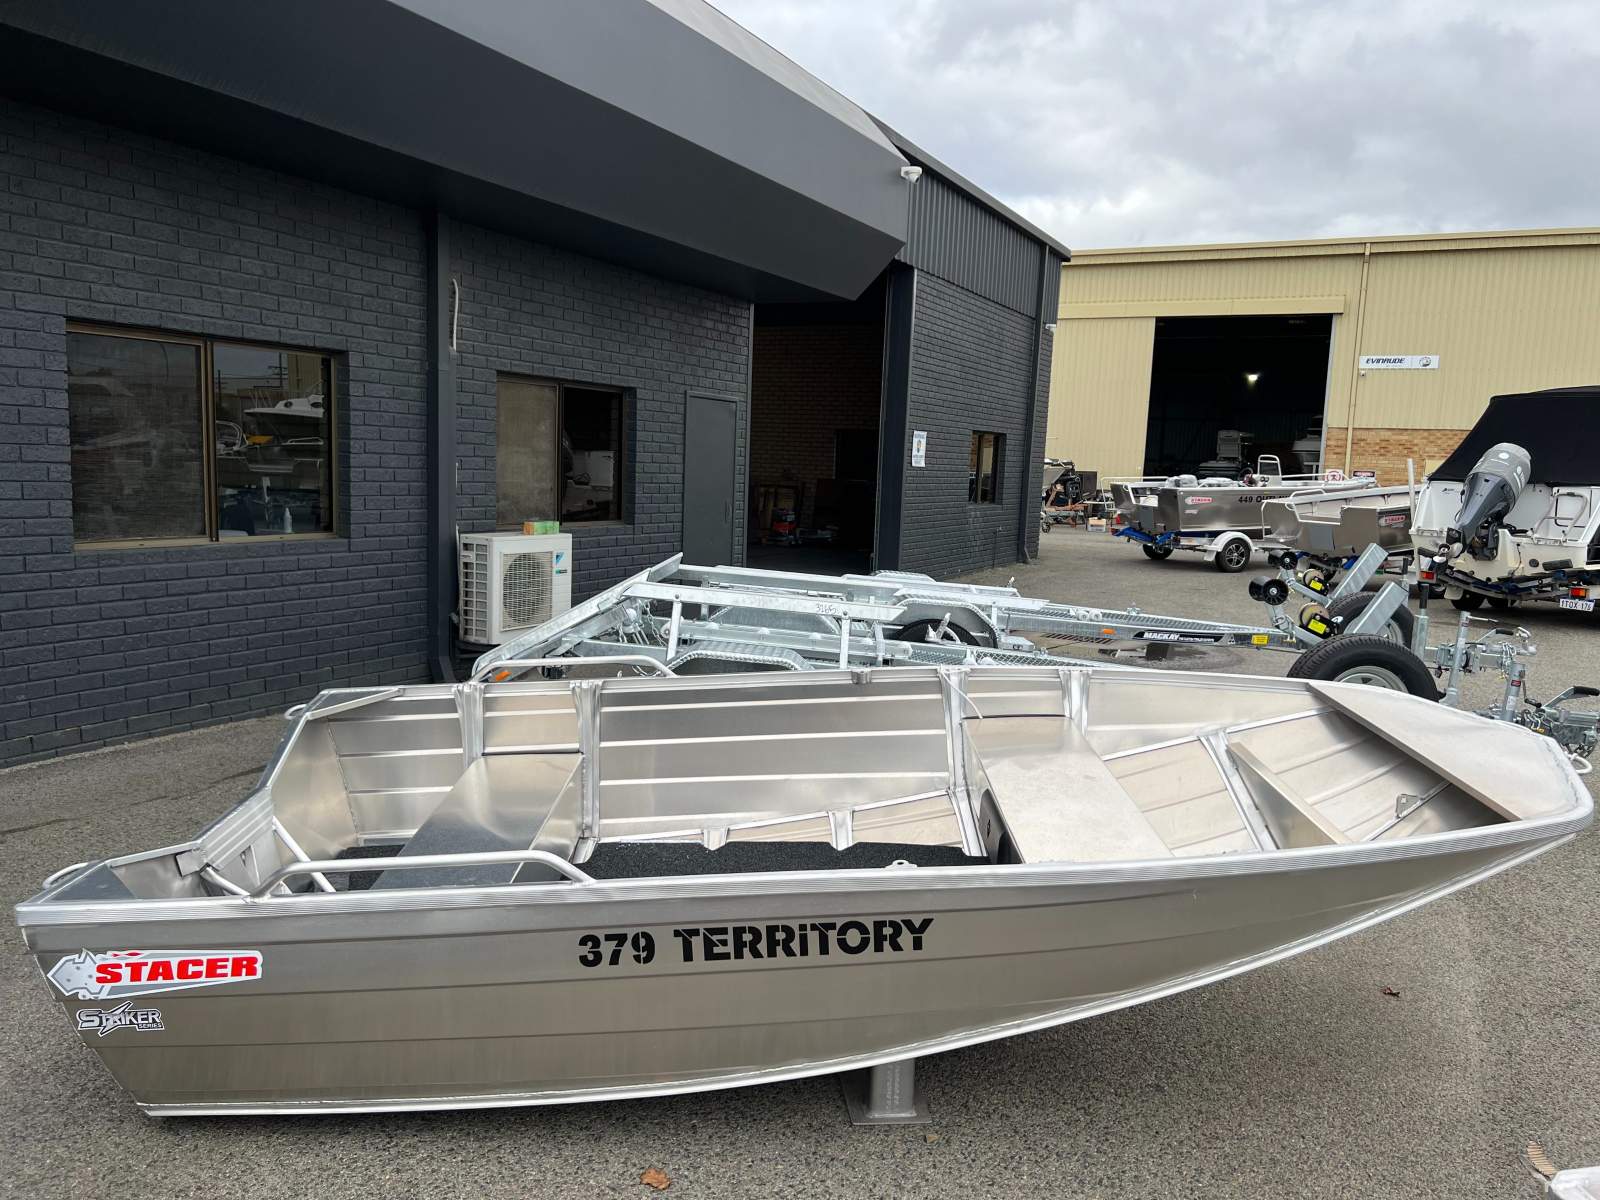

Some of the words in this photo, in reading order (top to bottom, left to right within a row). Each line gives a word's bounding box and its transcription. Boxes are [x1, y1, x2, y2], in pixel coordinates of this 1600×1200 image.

[1366, 357, 1405, 365] EVINRUDE
[1143, 632, 1180, 641] MACKAY
[578, 931, 655, 968] 379
[673, 918, 935, 963] TERRITORY
[95, 955, 259, 984] STACER
[79, 1009, 161, 1028] STRIKER
